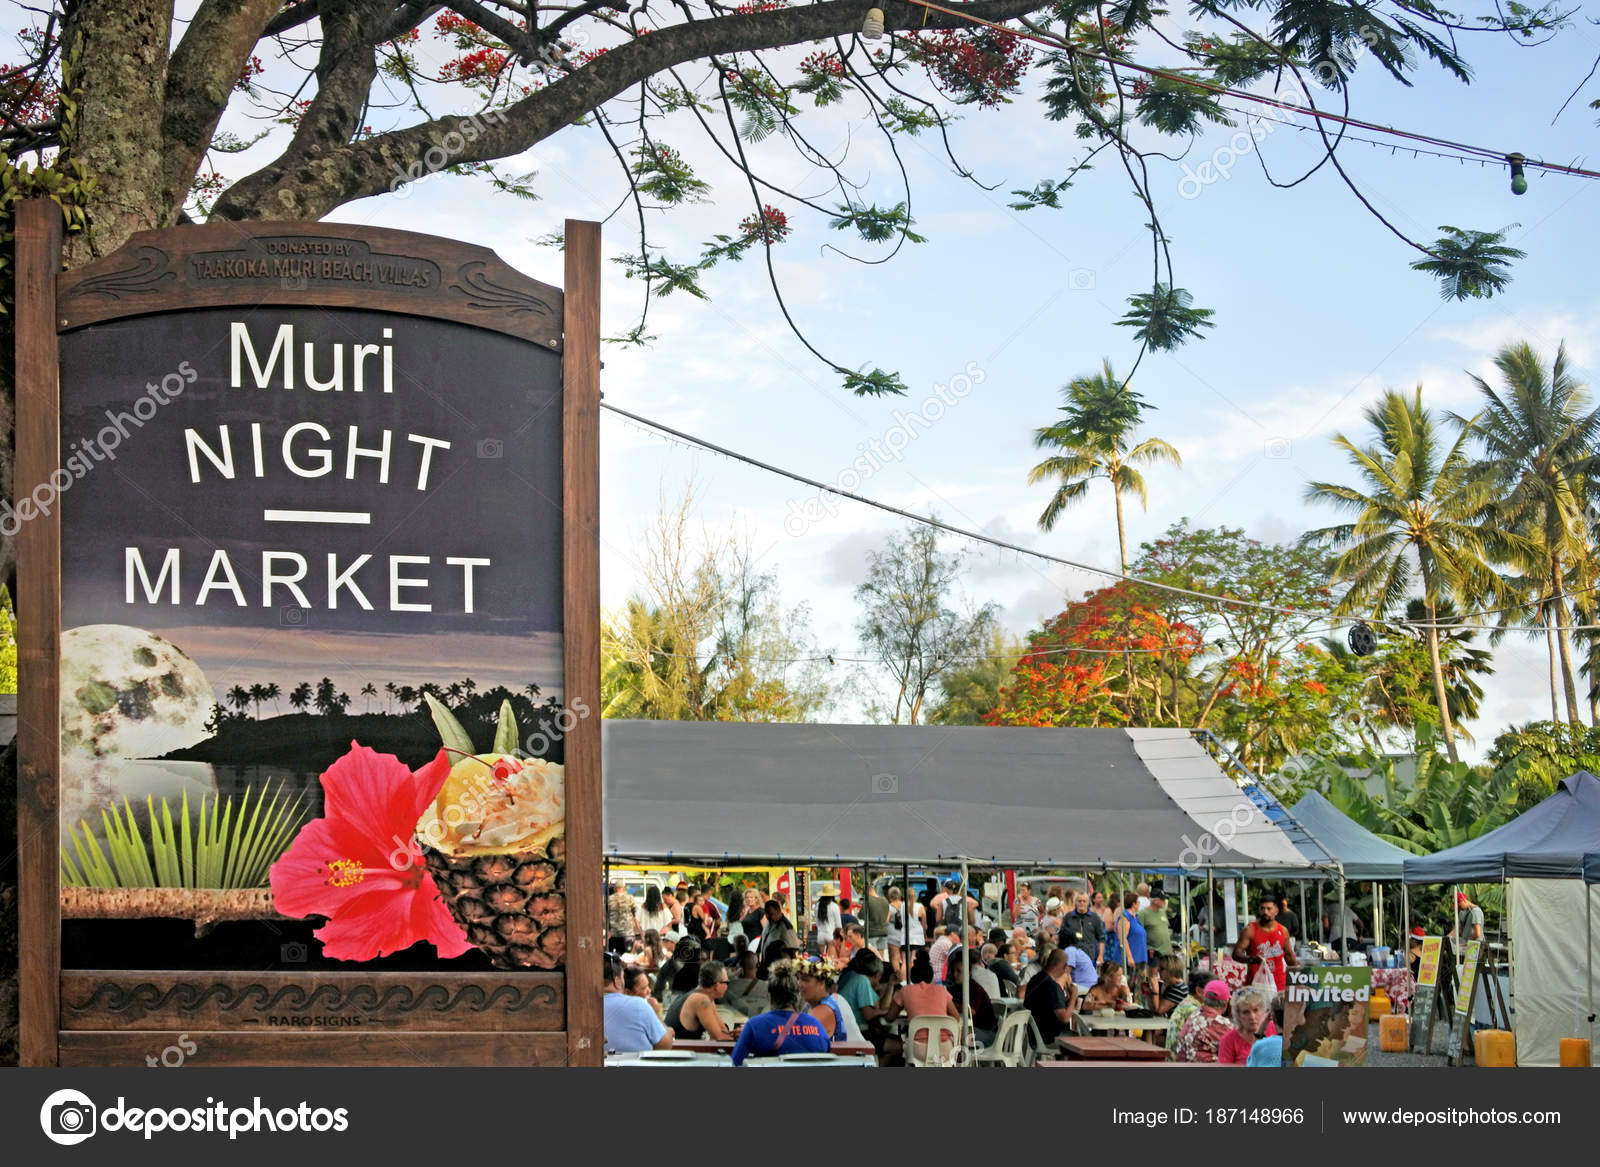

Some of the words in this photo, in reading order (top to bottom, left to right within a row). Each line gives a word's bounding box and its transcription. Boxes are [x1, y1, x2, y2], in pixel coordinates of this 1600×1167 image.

[267, 241, 332, 255] DONATED
[335, 241, 352, 256] BY
[193, 259, 269, 279] TAAKOKA
[274, 258, 316, 281] MURI
[323, 260, 373, 282] BEACH
[379, 265, 432, 288] VILLAS
[231, 323, 392, 393] Muri
[185, 422, 450, 490] NIGHT
[126, 548, 490, 613] MARKET
[1289, 971, 1318, 984] You
[1323, 971, 1353, 984] Are
[1288, 985, 1370, 1003] Invited
[268, 1015, 361, 1026] RAROSIGNS
